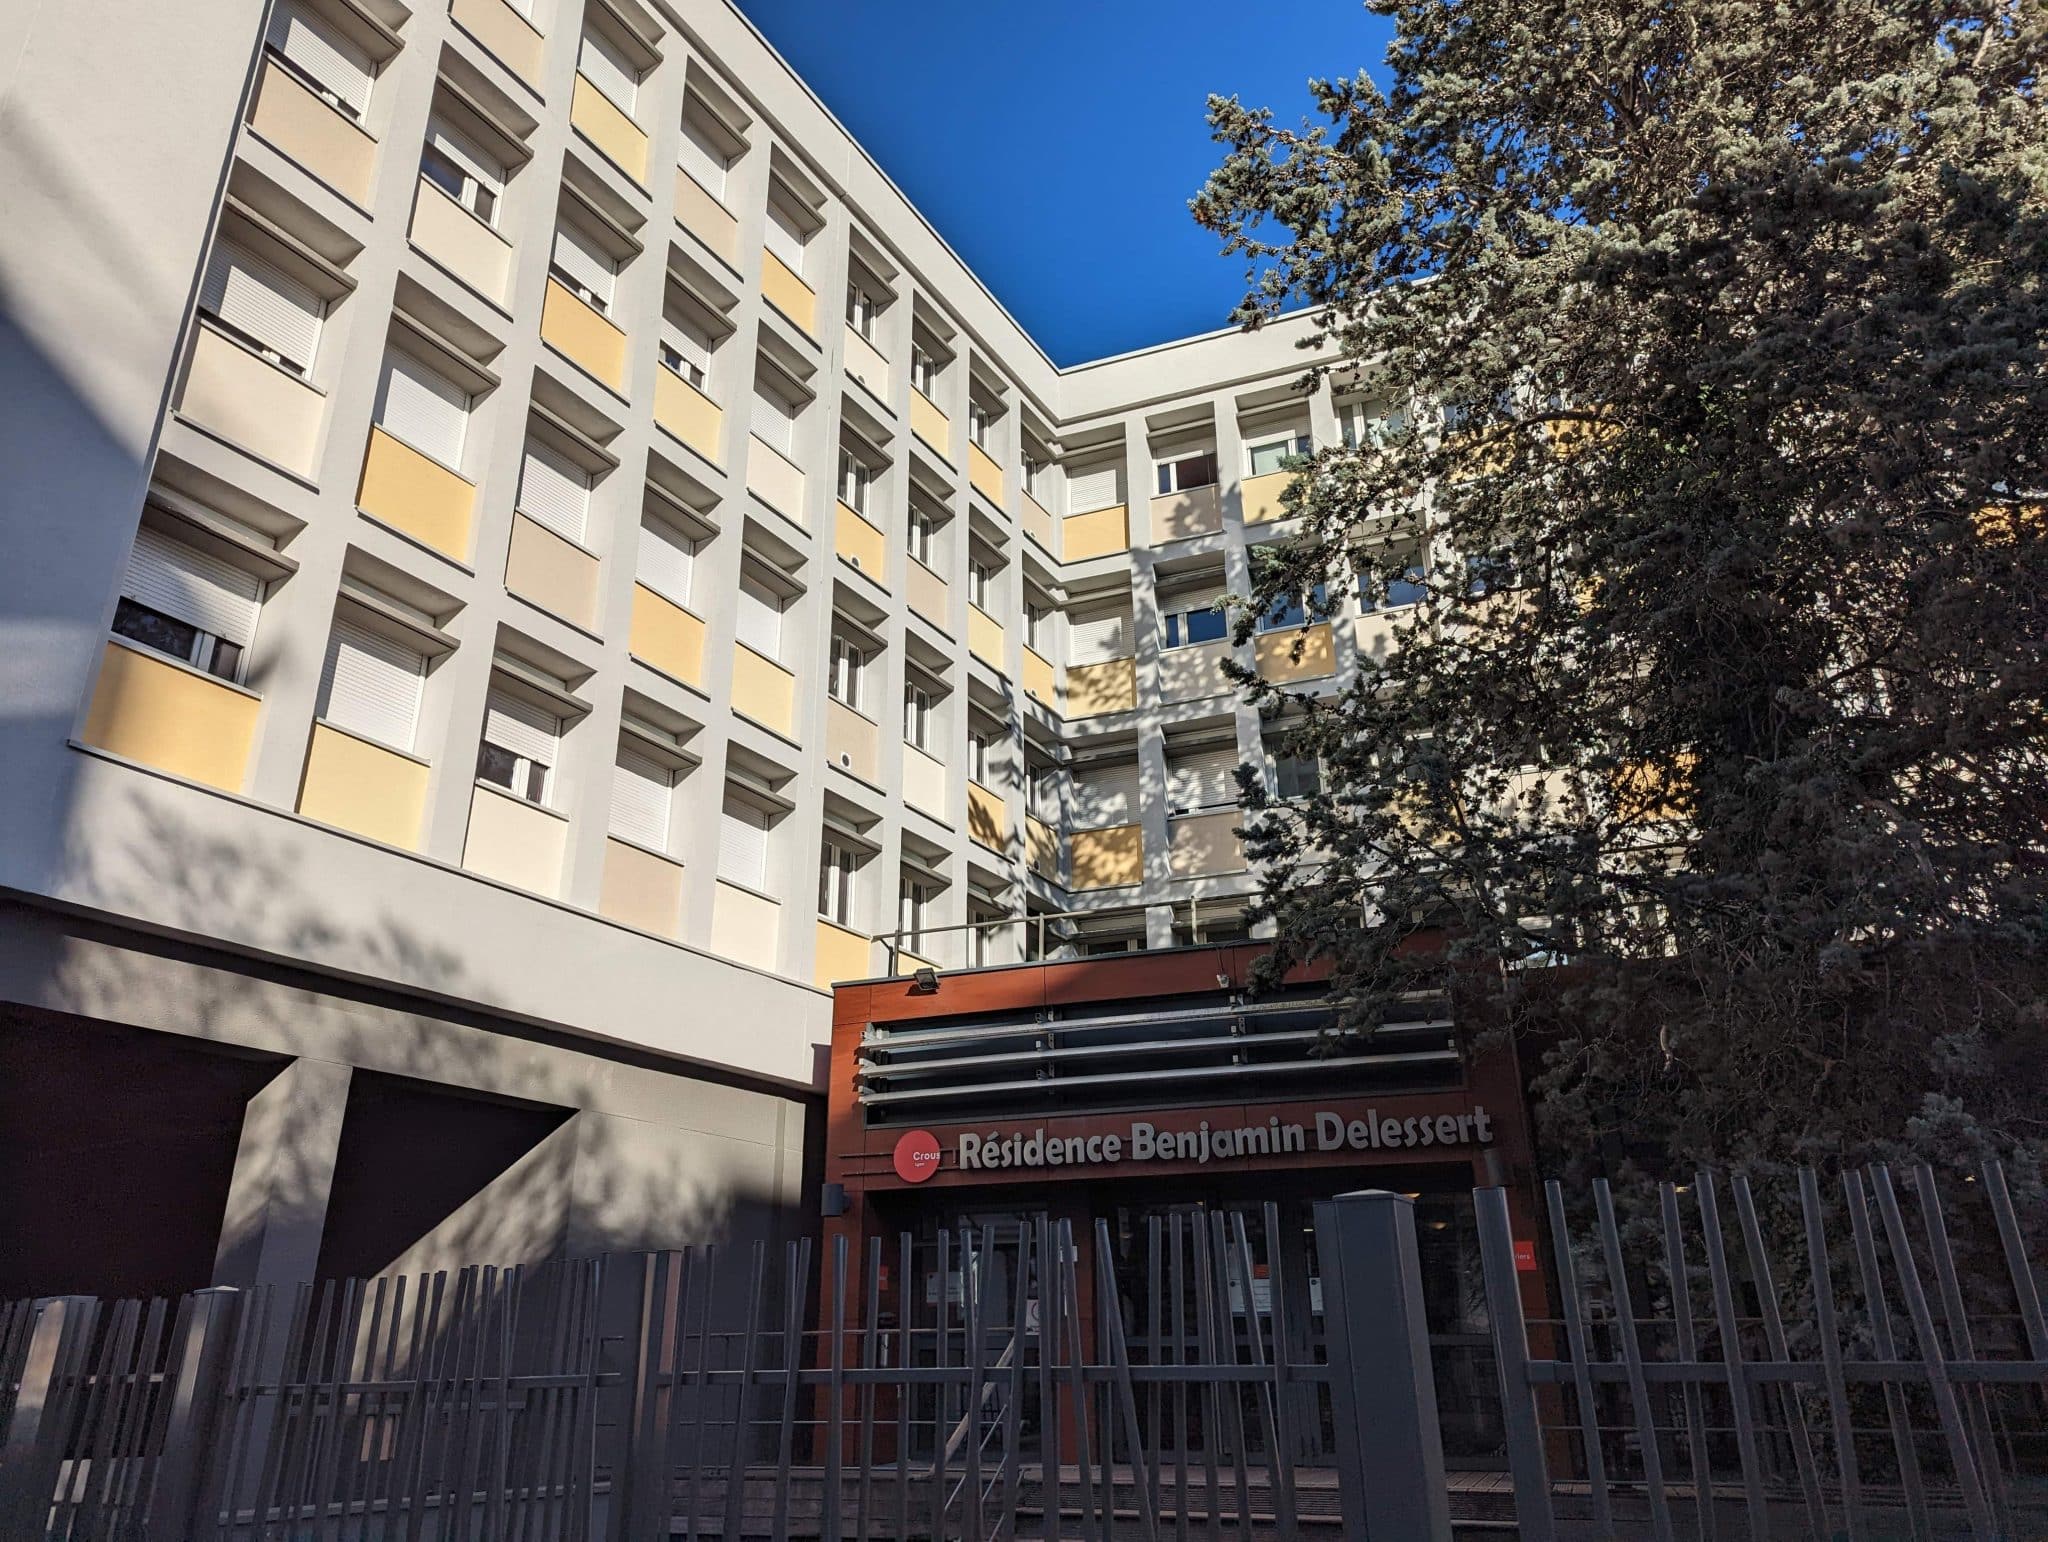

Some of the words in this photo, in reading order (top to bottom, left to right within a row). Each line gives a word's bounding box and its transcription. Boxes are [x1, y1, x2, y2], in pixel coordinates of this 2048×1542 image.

[959, 1128, 1122, 1170] Résidence
[1131, 1116, 1306, 1165] Benjamin
[1314, 1105, 1494, 1151] Delessert
